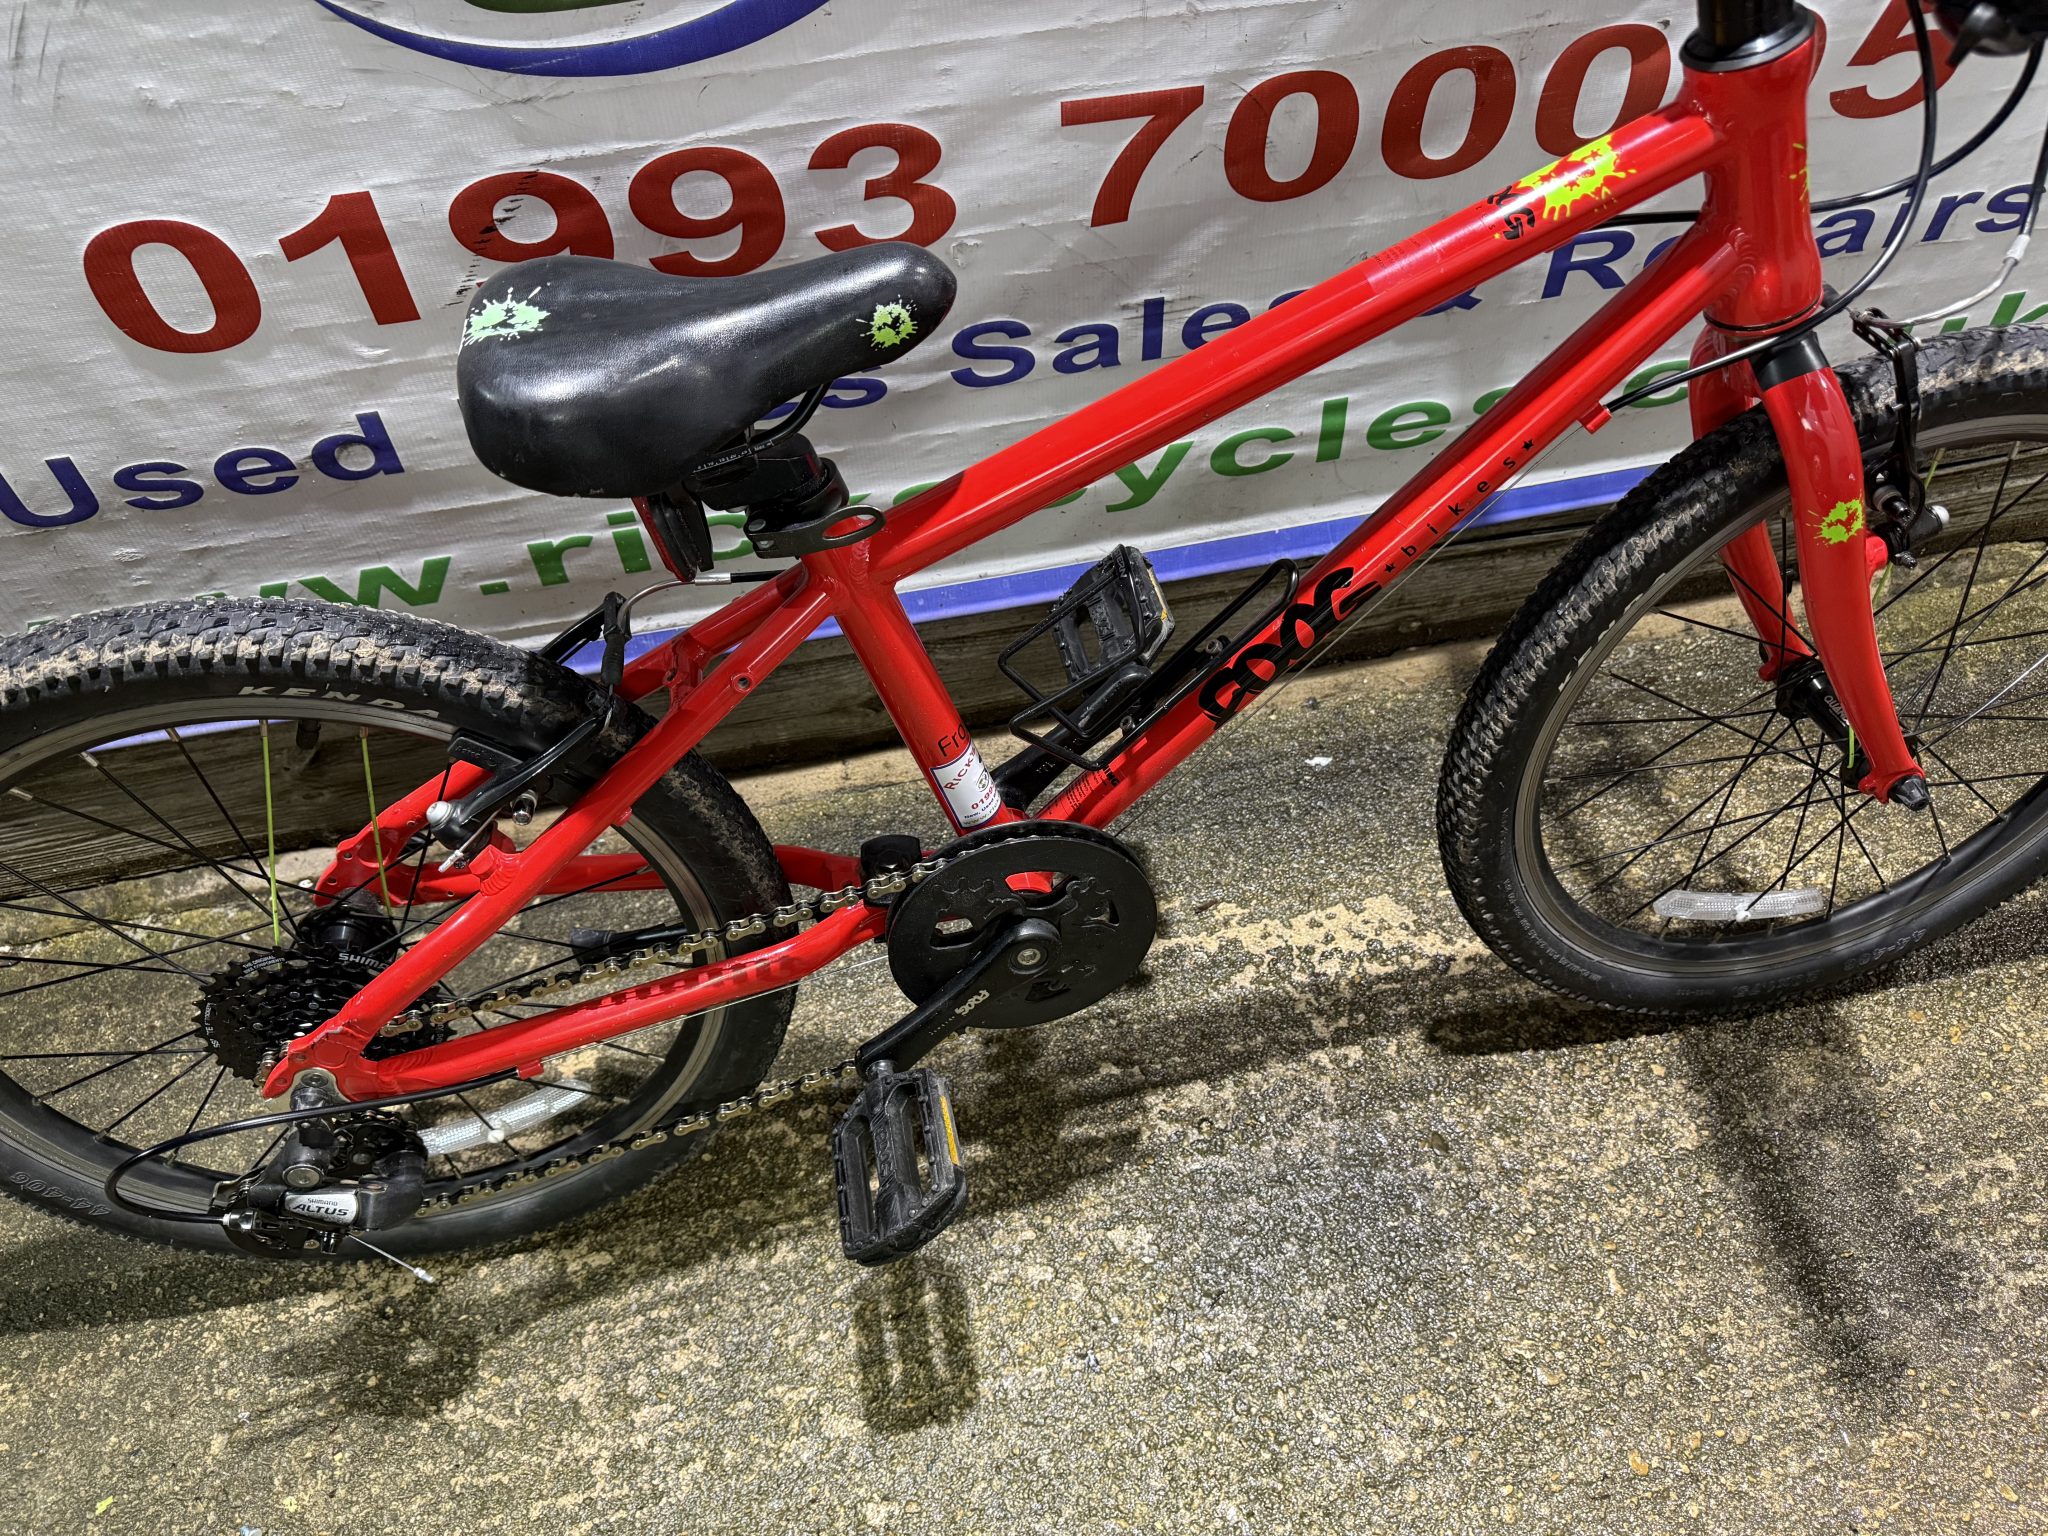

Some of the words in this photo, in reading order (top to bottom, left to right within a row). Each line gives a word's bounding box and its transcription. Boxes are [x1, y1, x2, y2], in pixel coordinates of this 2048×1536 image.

[83, 122, 957, 354] 01993
[0, 410, 405, 527] Used
[951, 288, 1310, 388] Sale
[1401, 457, 1517, 558] bikes
[237, 685, 442, 719] KENDA
[9, 1171, 112, 1216] 44-406
[292, 1203, 350, 1218] ALTUS
[306, 1197, 339, 1208] SHIMANO
